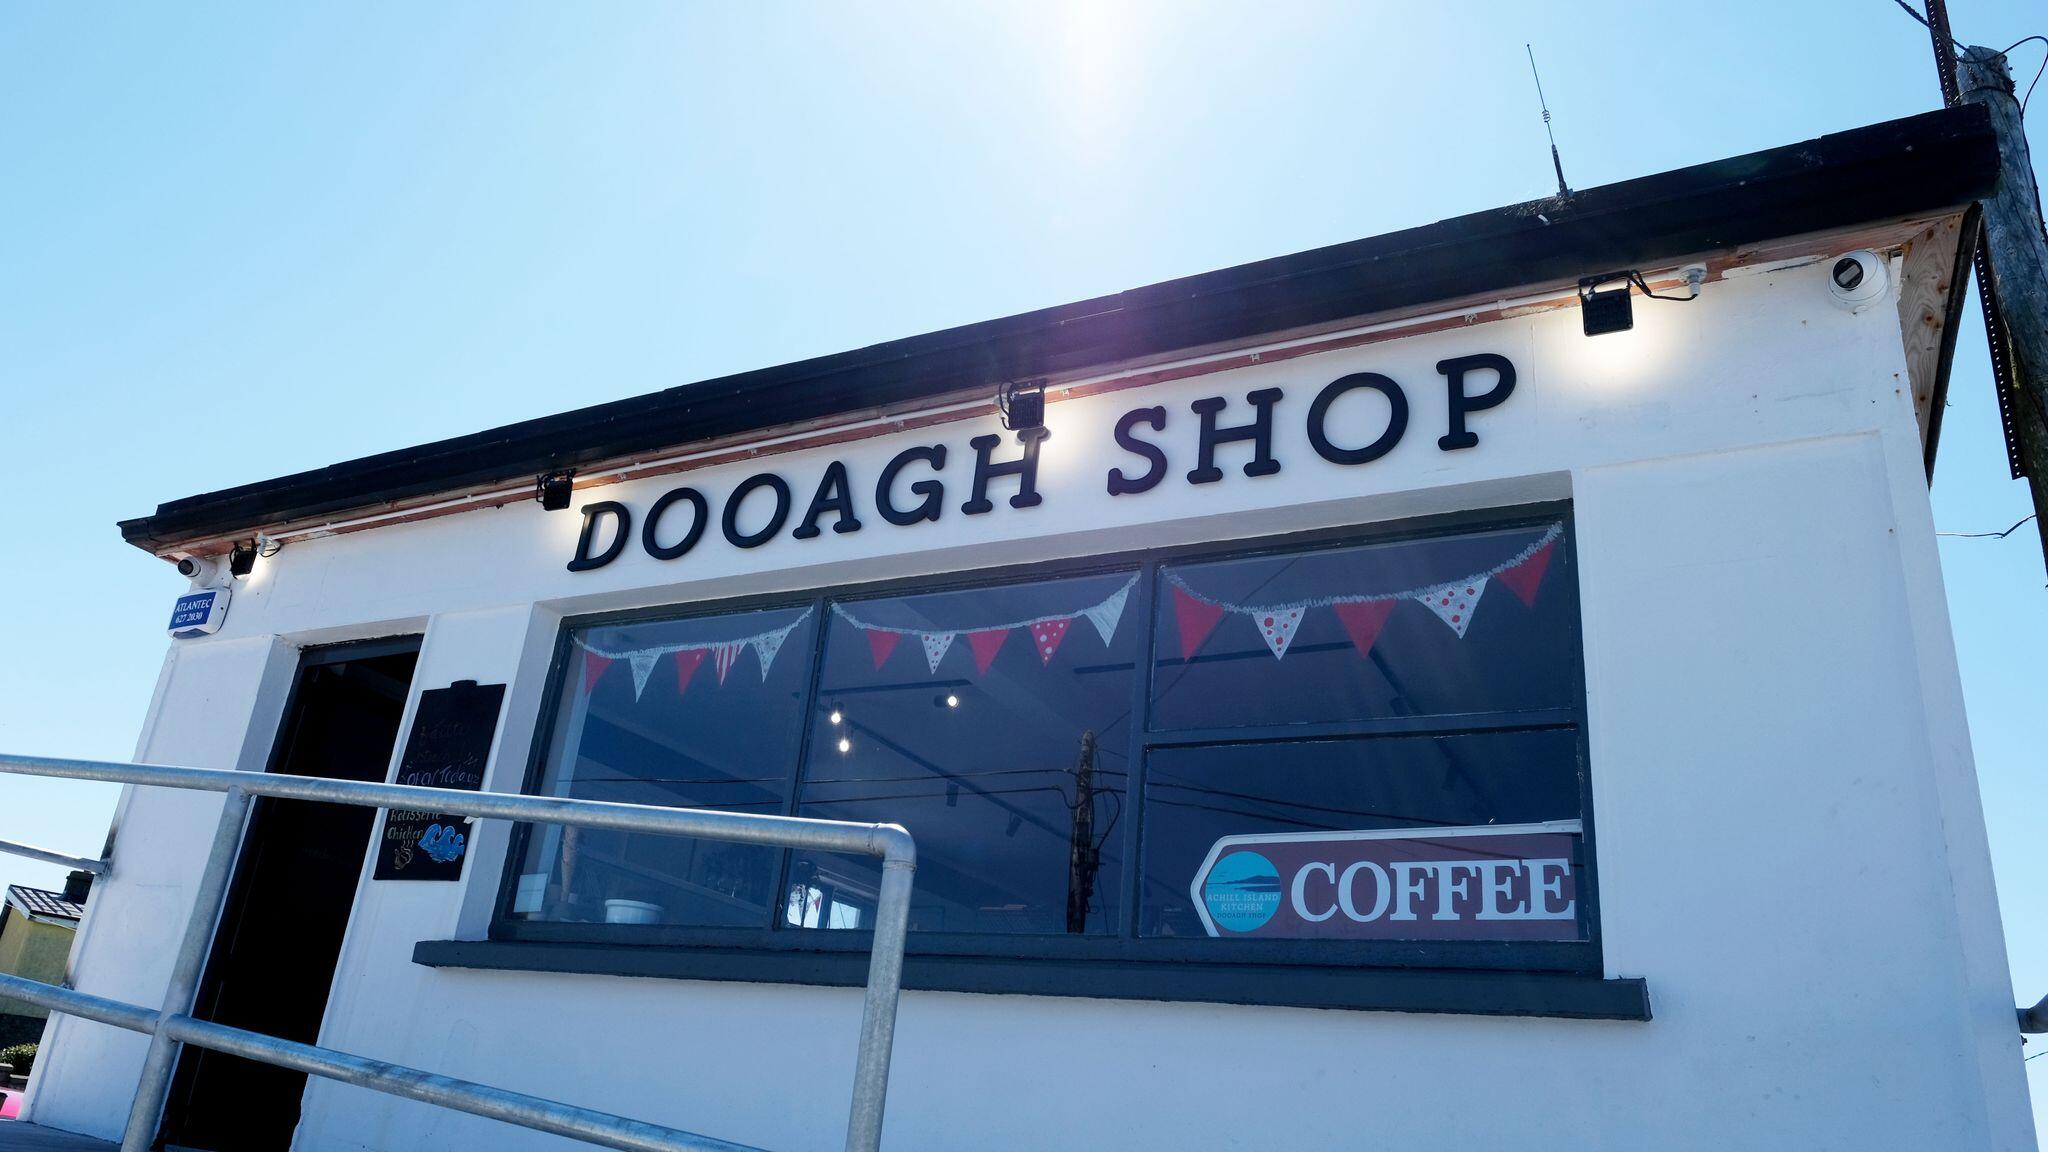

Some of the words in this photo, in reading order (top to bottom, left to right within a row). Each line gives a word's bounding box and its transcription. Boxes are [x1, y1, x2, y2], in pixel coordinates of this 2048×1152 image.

[567, 426, 1052, 572] DOOAGH
[1107, 353, 1517, 496] SHOP
[175, 599, 212, 613] ATLANTEC
[1291, 858, 1575, 922] COFFEE
[1207, 894, 1240, 902] ACHILL
[1243, 894, 1279, 902] ISLAND
[1220, 903, 1264, 911] KITCHEN
